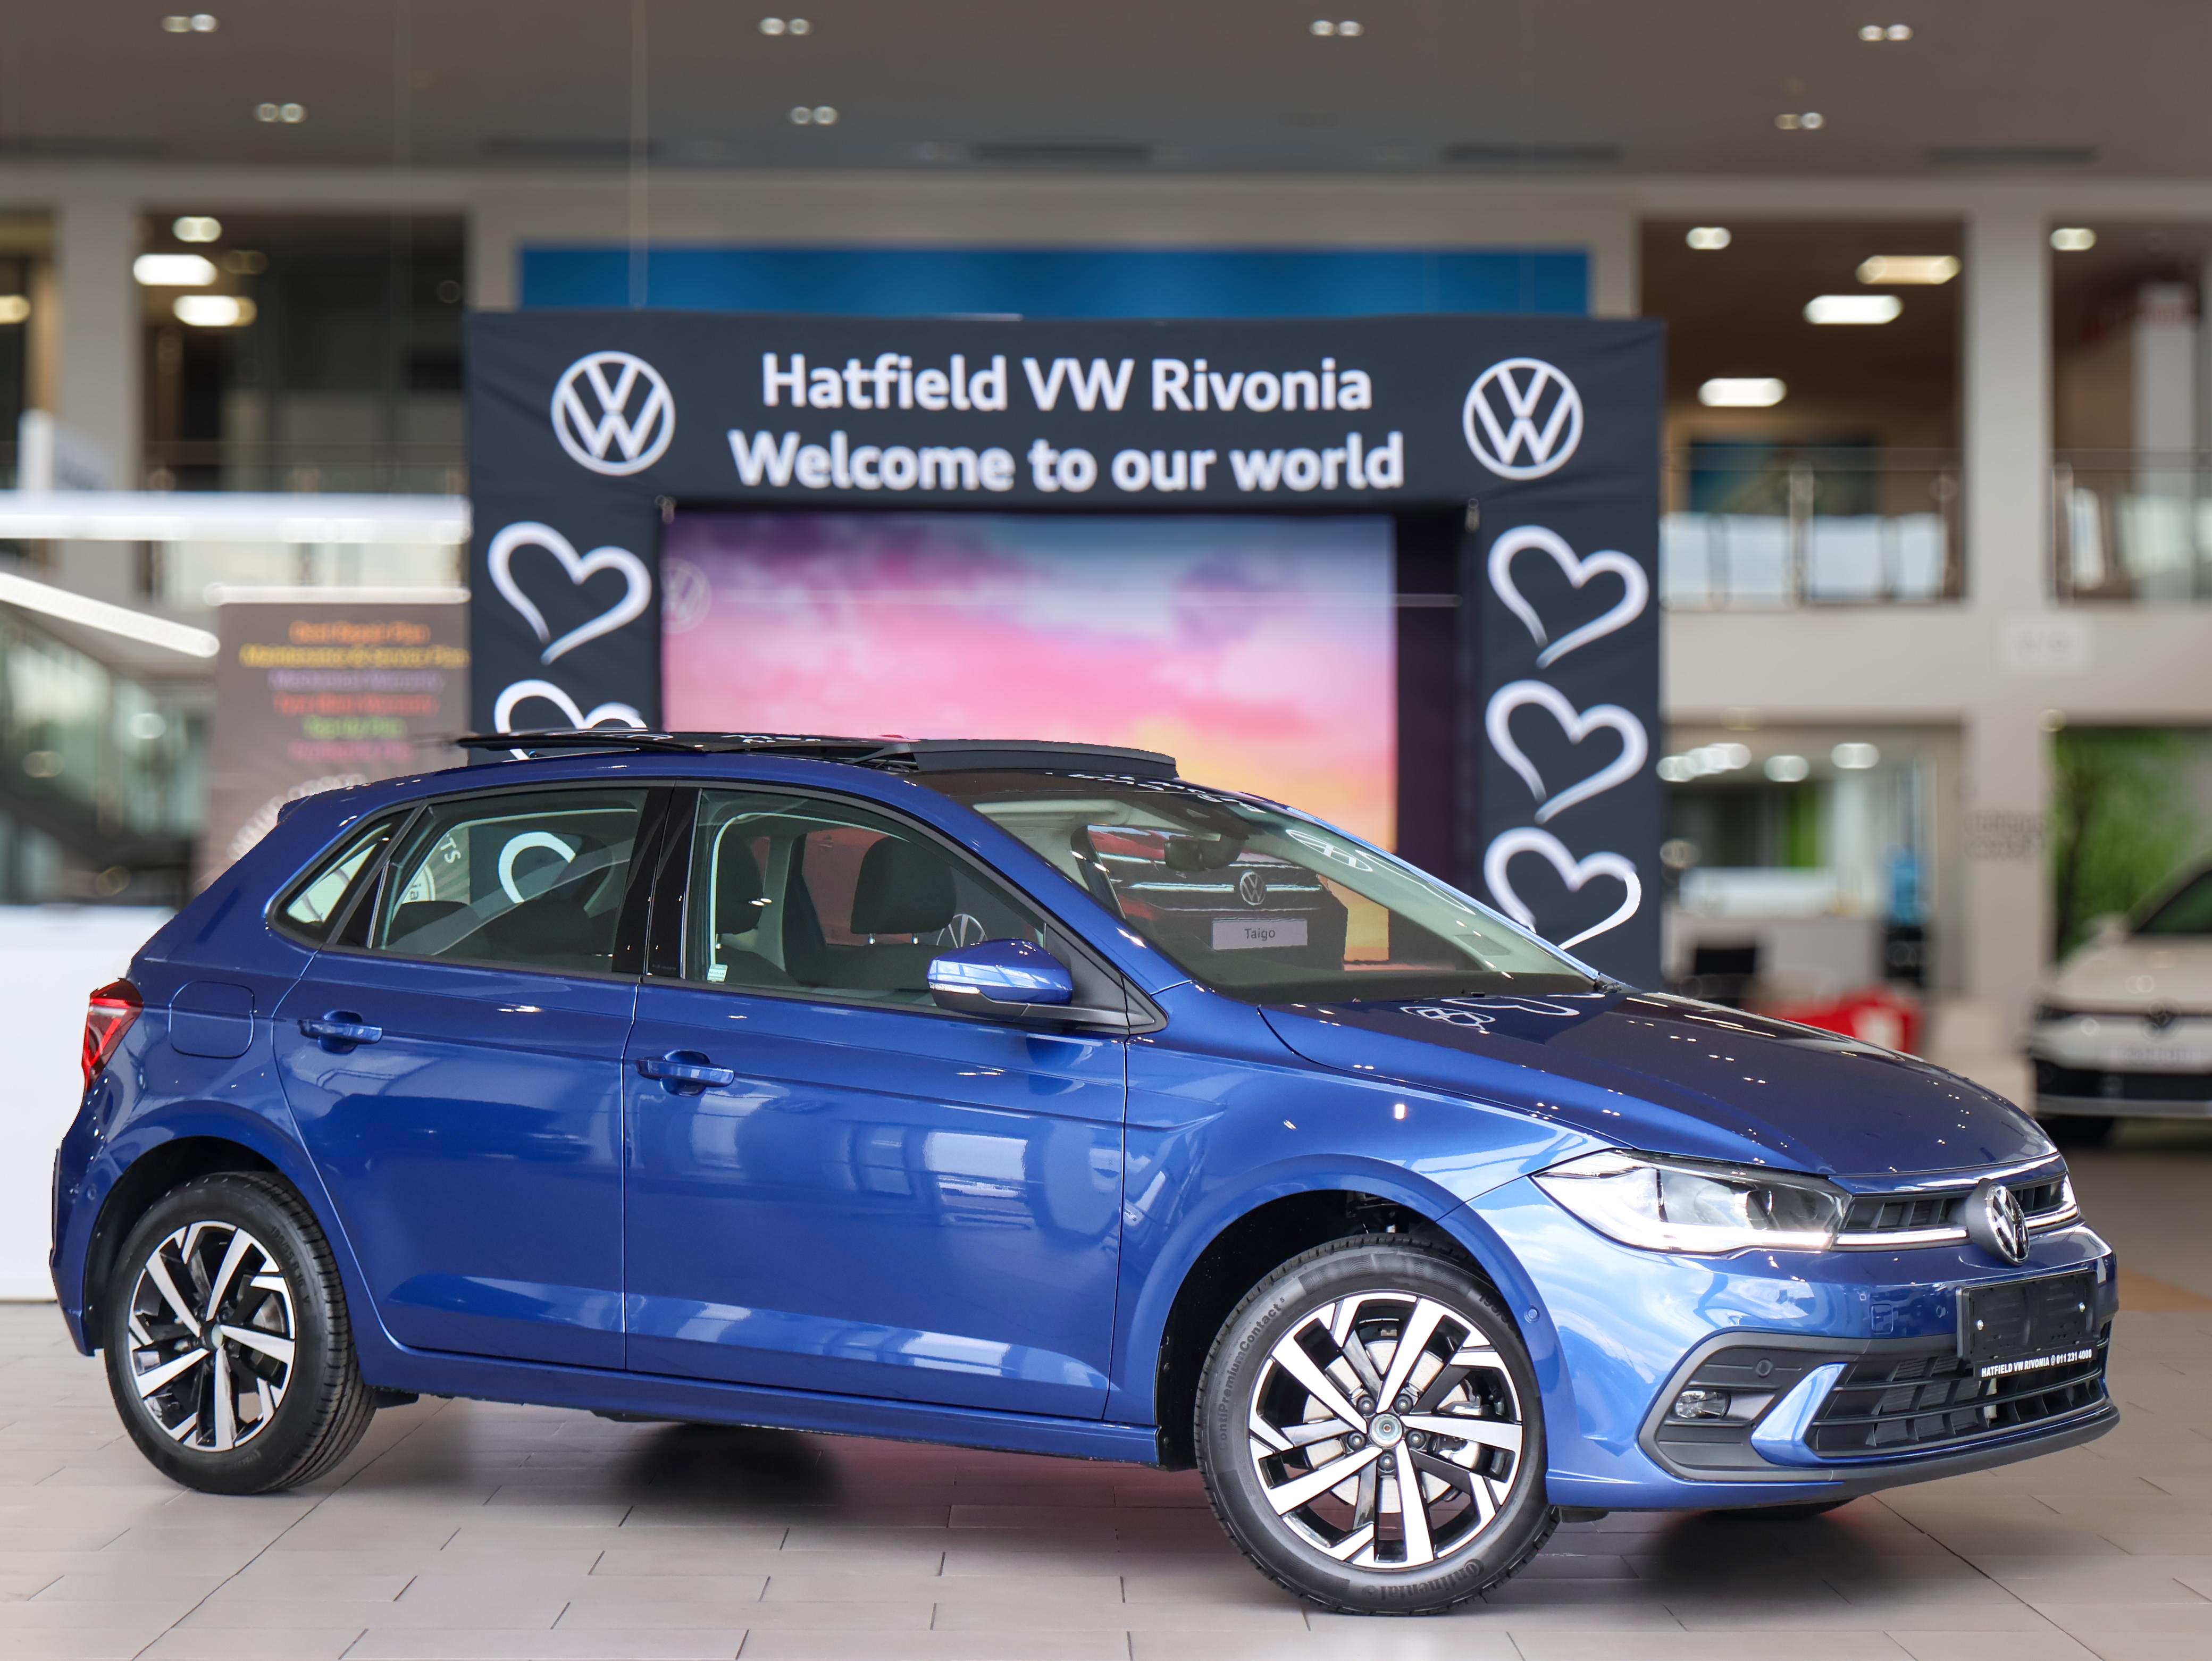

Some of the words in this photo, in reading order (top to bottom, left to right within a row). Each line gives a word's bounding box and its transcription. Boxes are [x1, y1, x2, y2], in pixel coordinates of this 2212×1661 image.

[763, 352, 1007, 412] Hatfield
[1023, 357, 1135, 412] VW
[1152, 357, 1372, 413] Rivonia
[727, 429, 1015, 492] Welcome
[1027, 439, 1097, 492] to
[1111, 449, 1217, 492] our
[1229, 431, 1403, 491] world
[1244, 927, 1276, 942] Taigo
[1981, 1362, 2013, 1378] HATFIELD
[2013, 1361, 2024, 1372] VW
[2024, 1356, 2050, 1370] RIVONIA
[2056, 1353, 2067, 1364] 011
[2067, 1351, 2077, 1362] 231
[2078, 1348, 2092, 1360] 4000
